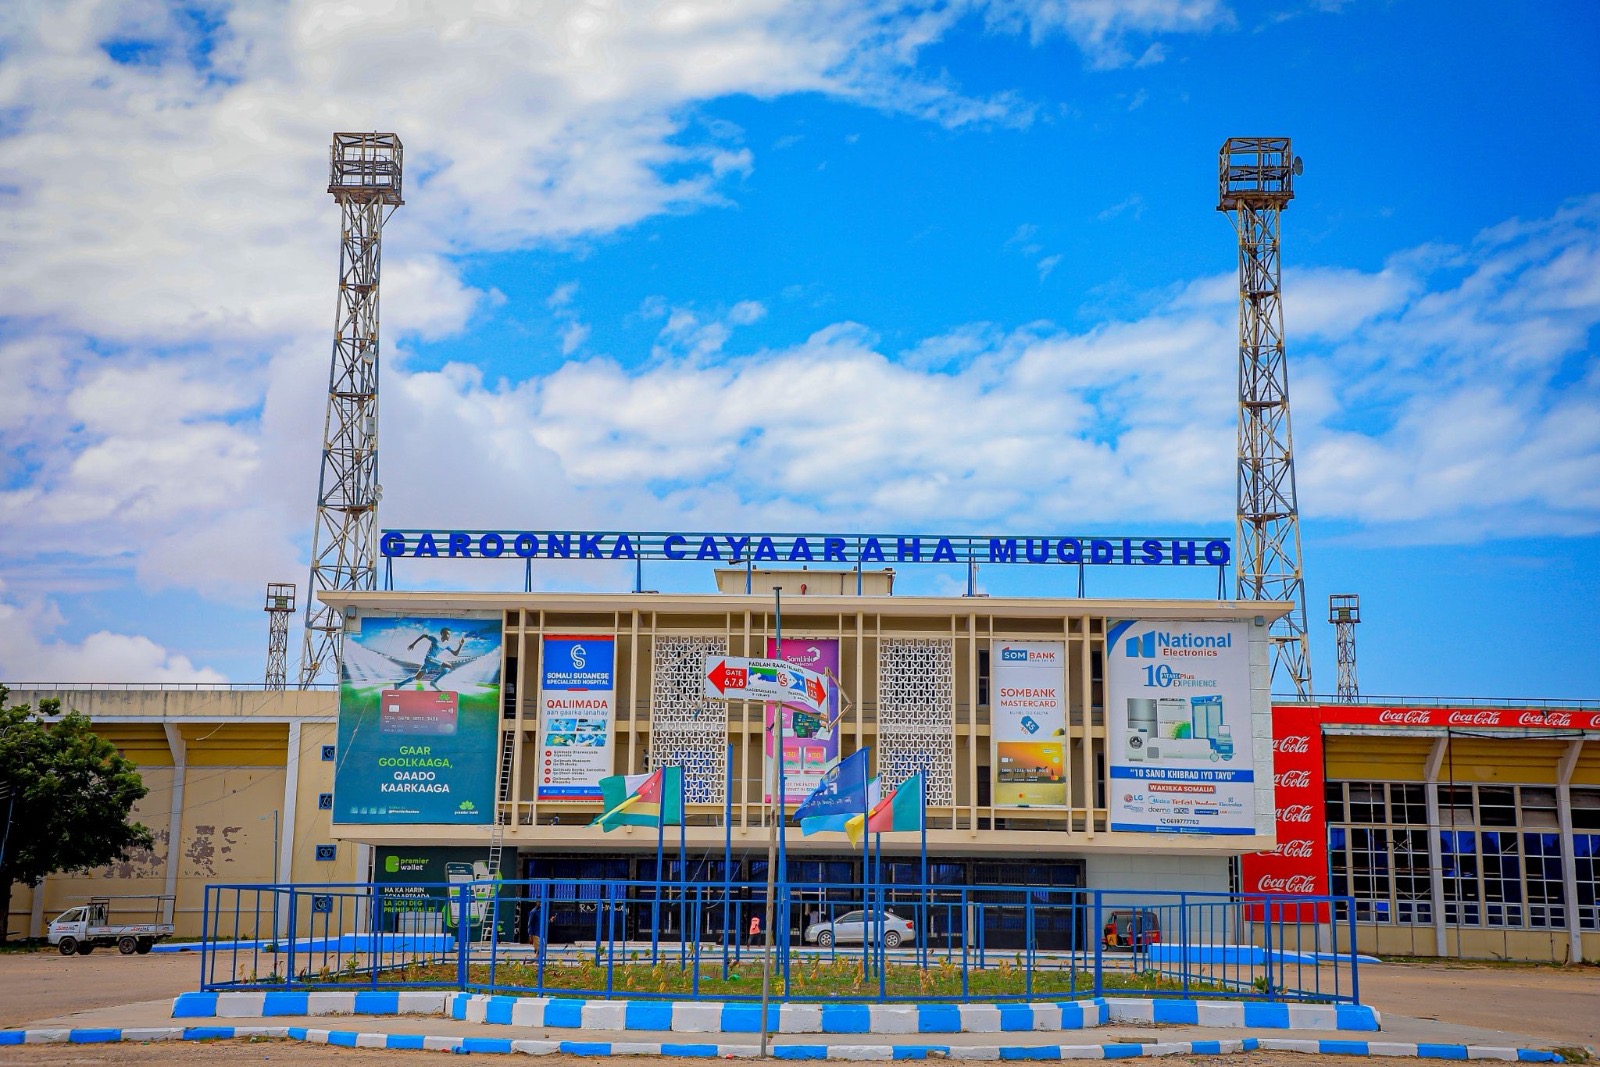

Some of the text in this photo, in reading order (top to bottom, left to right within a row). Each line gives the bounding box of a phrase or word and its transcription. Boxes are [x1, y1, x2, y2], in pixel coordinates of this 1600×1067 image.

[380, 532, 1230, 564] GAROONKA CAYAARAHA MUQDISHO
[1158, 632, 1231, 648] National
[1163, 648, 1218, 657] Electronics
[1142, 664, 1173, 688] 10
[724, 678, 744, 687] 6,7,8
[1000, 688, 1056, 698] SOMBANK
[546, 699, 608, 709] QALIIMADA
[1000, 700, 1057, 708] MASTERCARD
[1379, 709, 1431, 724] Coca-Cola
[1449, 710, 1501, 725] Coca-Cola
[1273, 735, 1311, 753] a-Cola
[399, 746, 431, 755] GAAR
[378, 758, 453, 768] GOOLKAAGA,
[393, 771, 436, 781] QAADO
[1146, 769, 1165, 778] SANO
[1167, 770, 1199, 779] KHIBRAD
[1201, 771, 1213, 780] IYO
[1274, 770, 1312, 788] a-Cola
[381, 783, 450, 793] KAARKAAGA
[1184, 785, 1214, 793] SOMALIA
[1275, 804, 1313, 823] a-Cola
[1258, 874, 1316, 893] Coca-Cola
